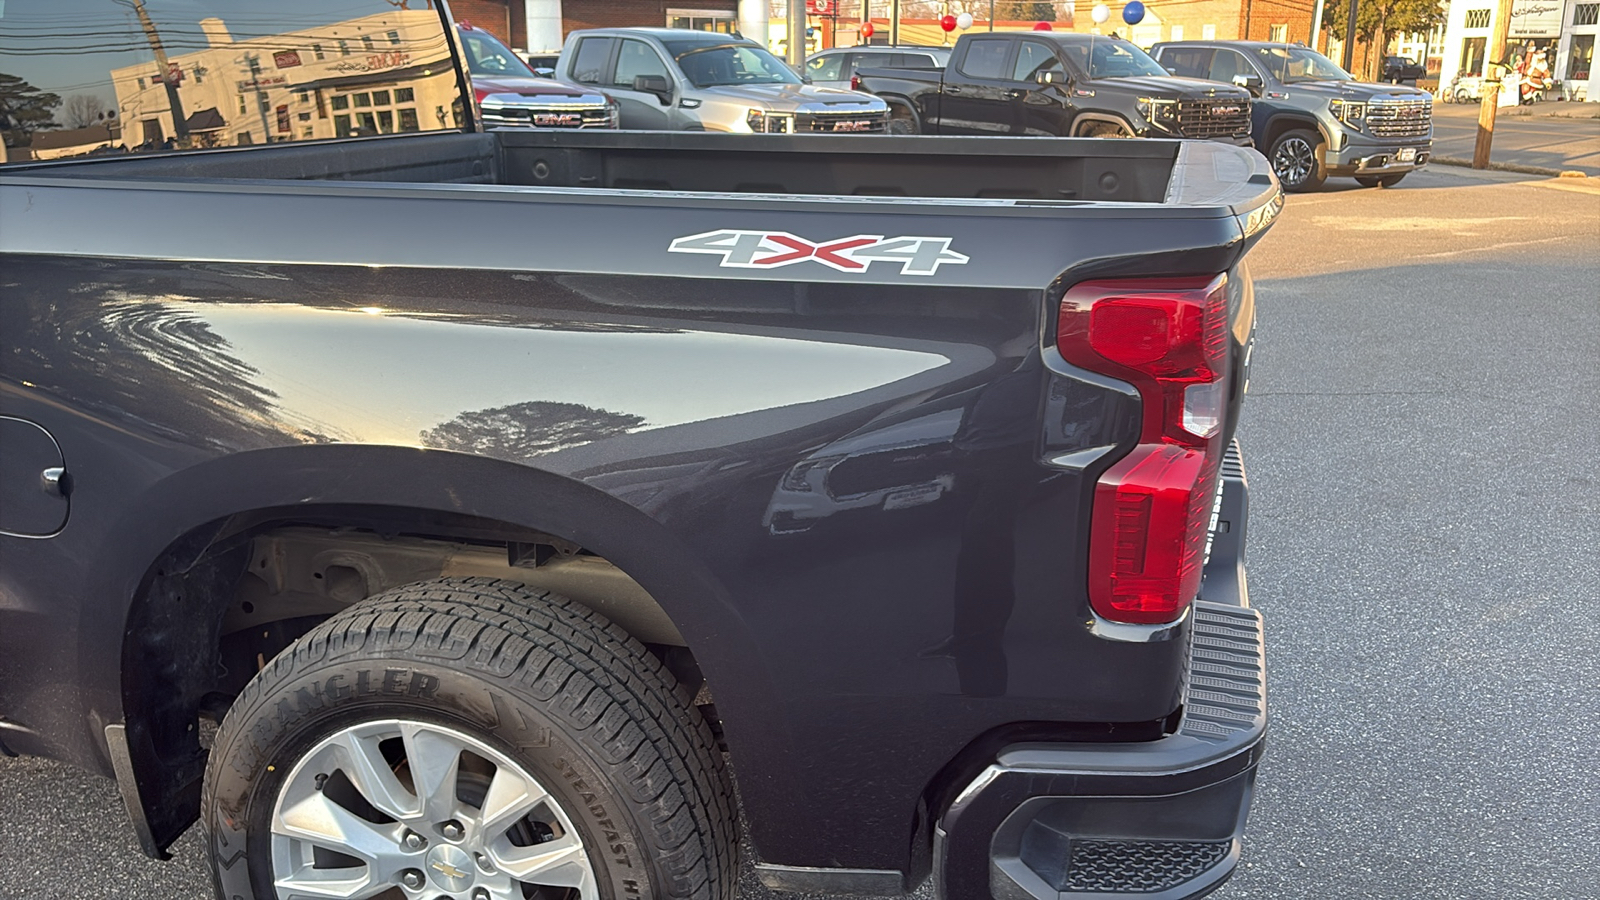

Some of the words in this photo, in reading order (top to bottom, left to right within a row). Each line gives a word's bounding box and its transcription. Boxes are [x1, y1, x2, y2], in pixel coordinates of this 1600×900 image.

[1212, 106, 1240, 115] GMC
[533, 113, 581, 125] GMC
[833, 120, 871, 131] GMC
[229, 669, 440, 781] WRANGLER
[552, 757, 633, 868] STEADFAST
